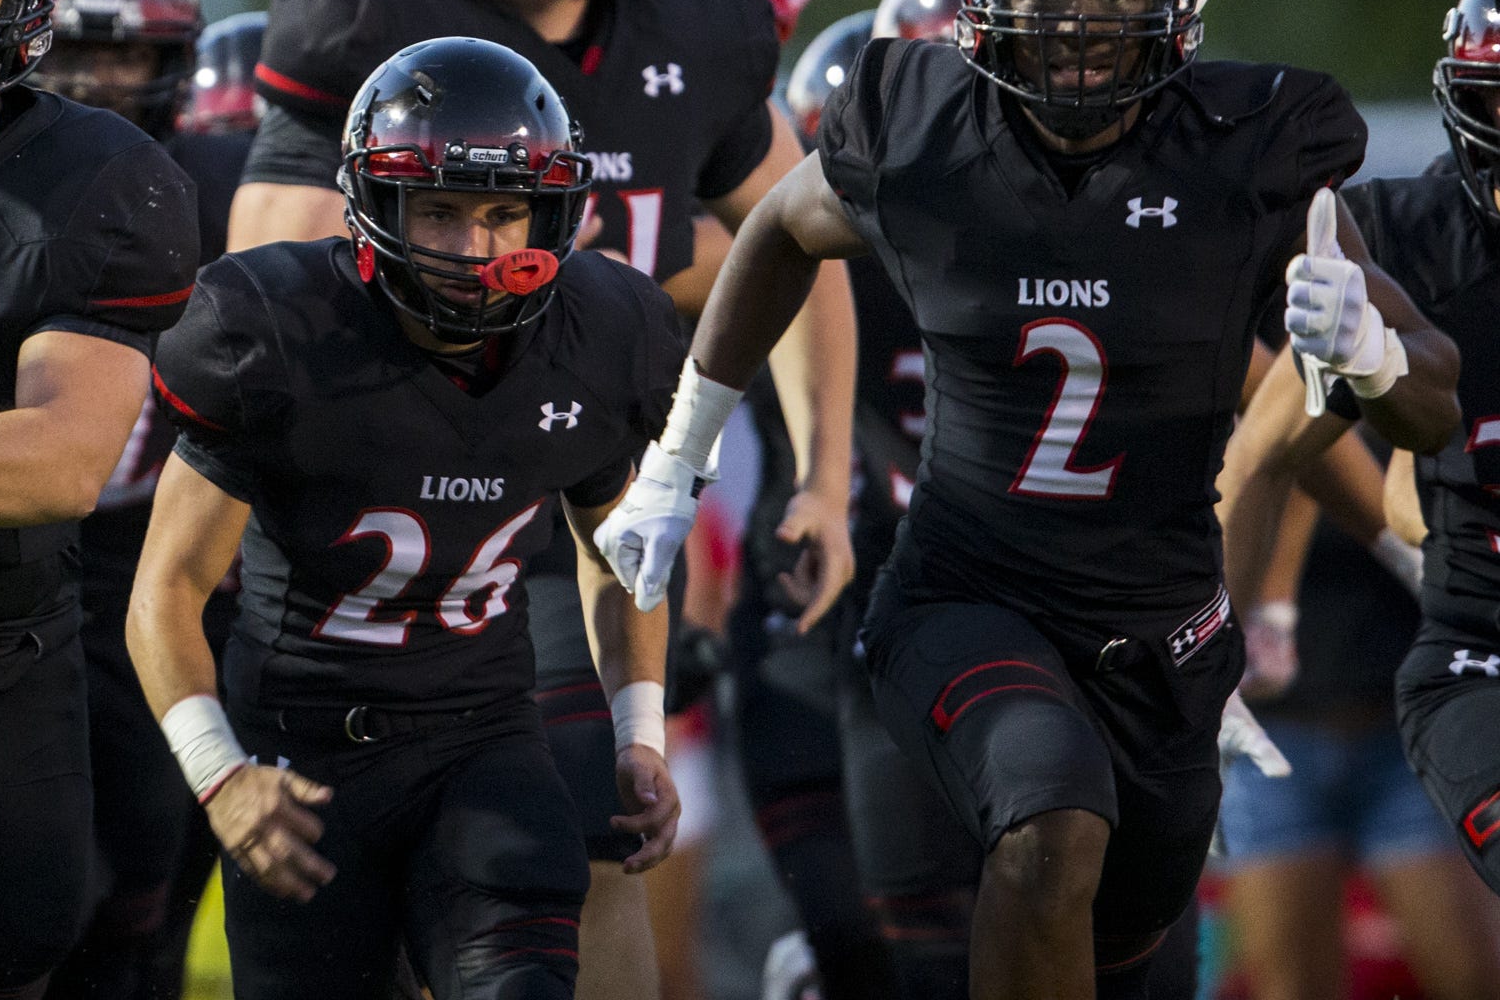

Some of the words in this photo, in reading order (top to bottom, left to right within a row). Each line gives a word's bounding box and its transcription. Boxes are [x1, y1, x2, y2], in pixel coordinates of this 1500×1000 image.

[471, 151, 507, 161] schutt
[583, 151, 634, 182] ONS
[1017, 277, 1111, 308] LIONS
[1008, 316, 1127, 500] 2
[419, 475, 505, 502] LIONS
[311, 497, 546, 648] 26
